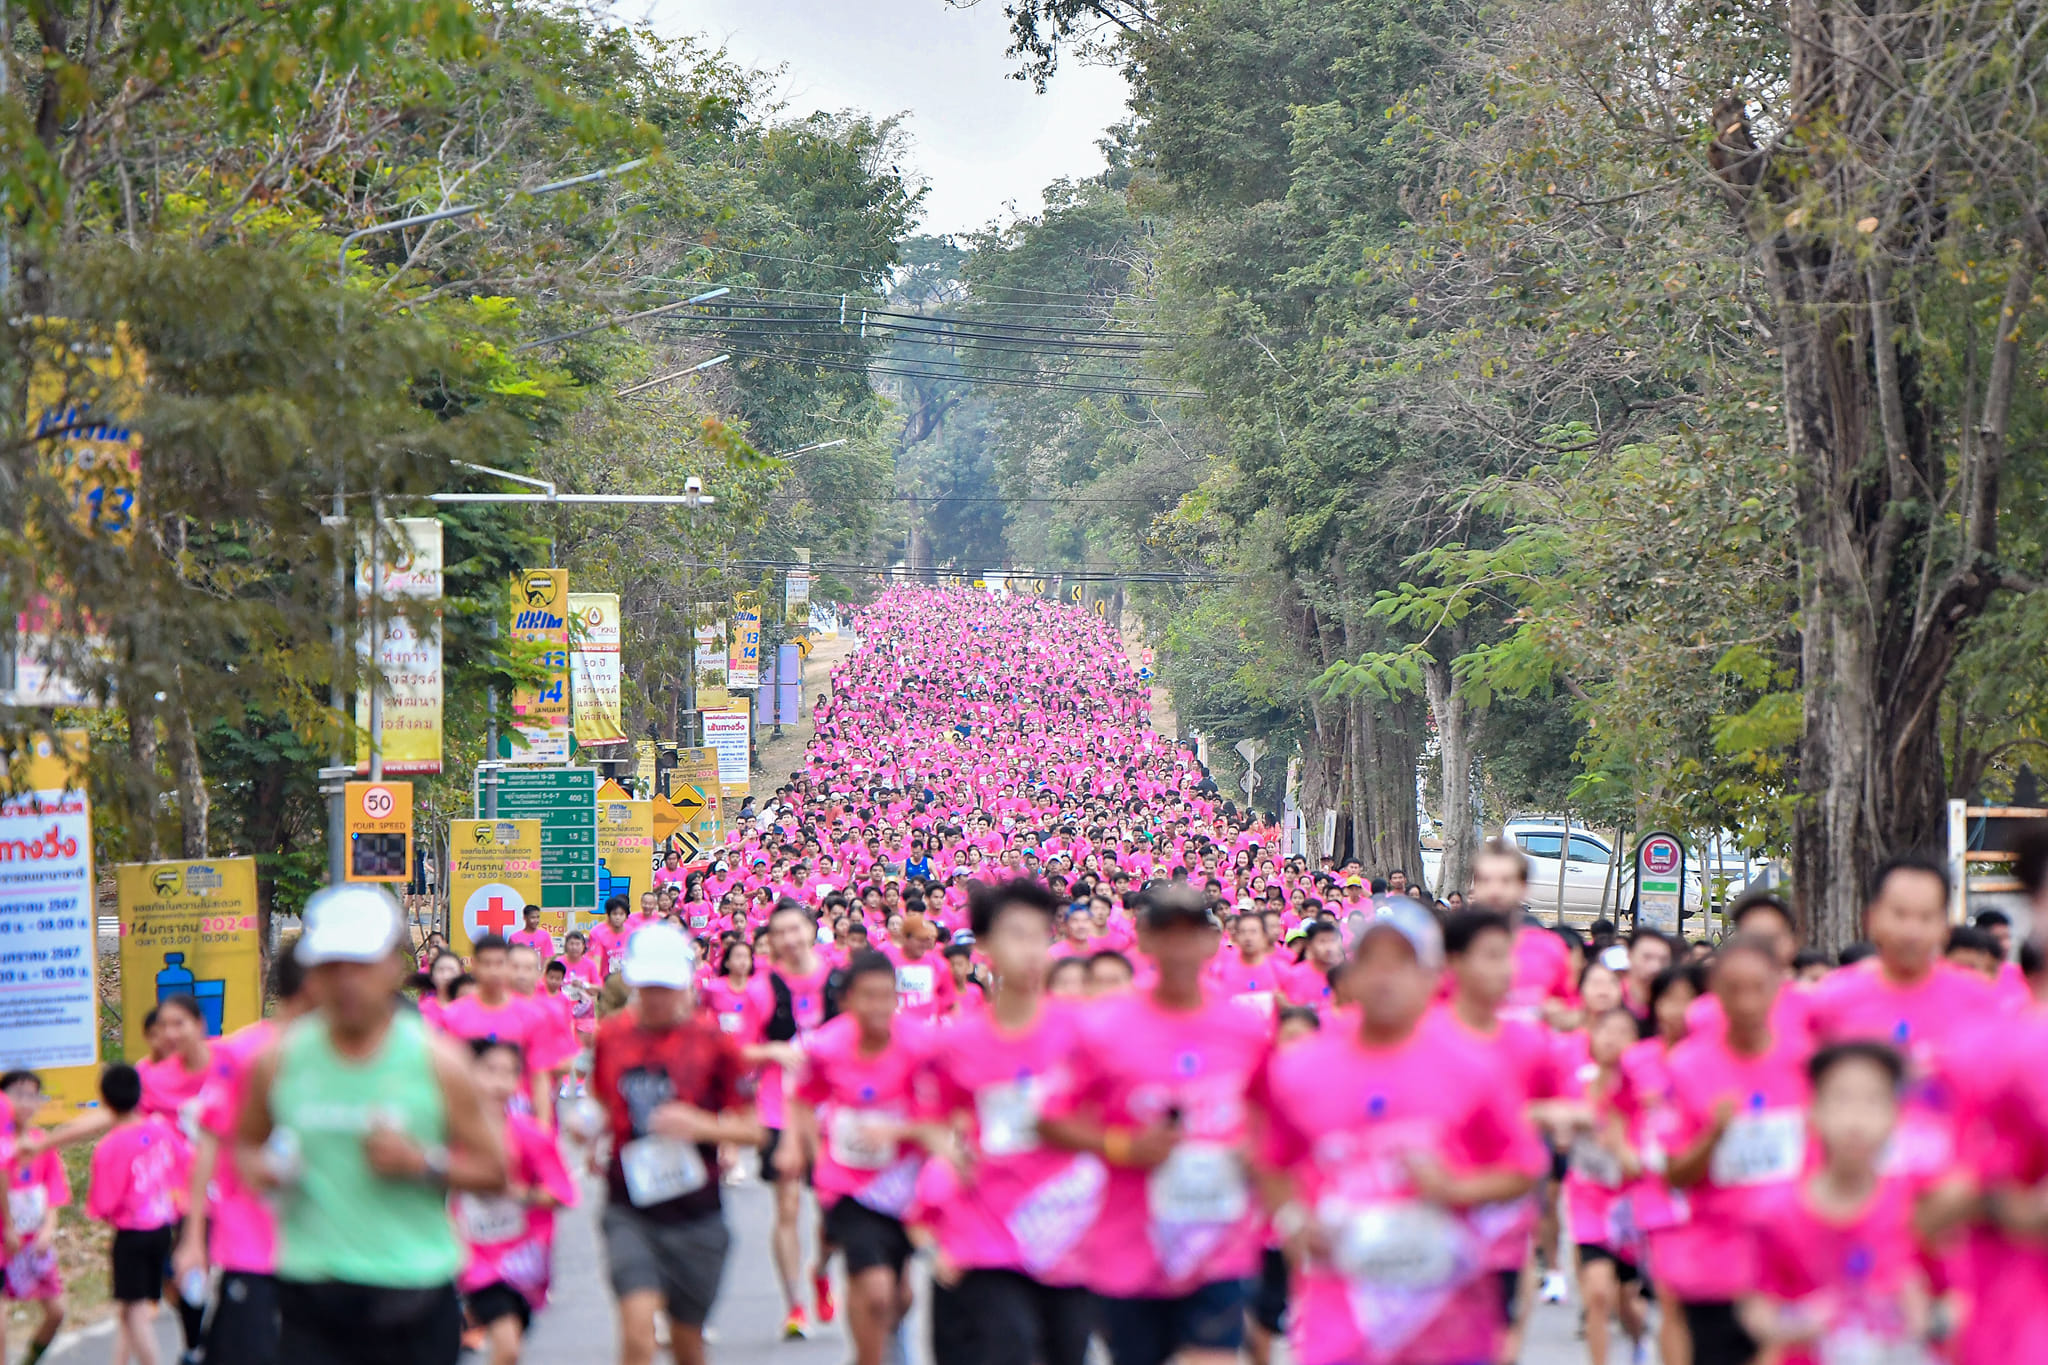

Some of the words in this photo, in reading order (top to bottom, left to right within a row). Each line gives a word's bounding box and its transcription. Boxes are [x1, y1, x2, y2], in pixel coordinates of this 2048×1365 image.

[747, 632, 759, 644] 13
[743, 647, 757, 659] 14
[538, 680, 563, 704] 14
[534, 706, 566, 714] JANUARY
[368, 795, 391, 811] 50
[353, 822, 375, 830] YOUR
[379, 822, 406, 830] SPEED
[457, 860, 470, 871] 14
[131, 922, 149, 935] 14
[201, 916, 250, 932] 2024
